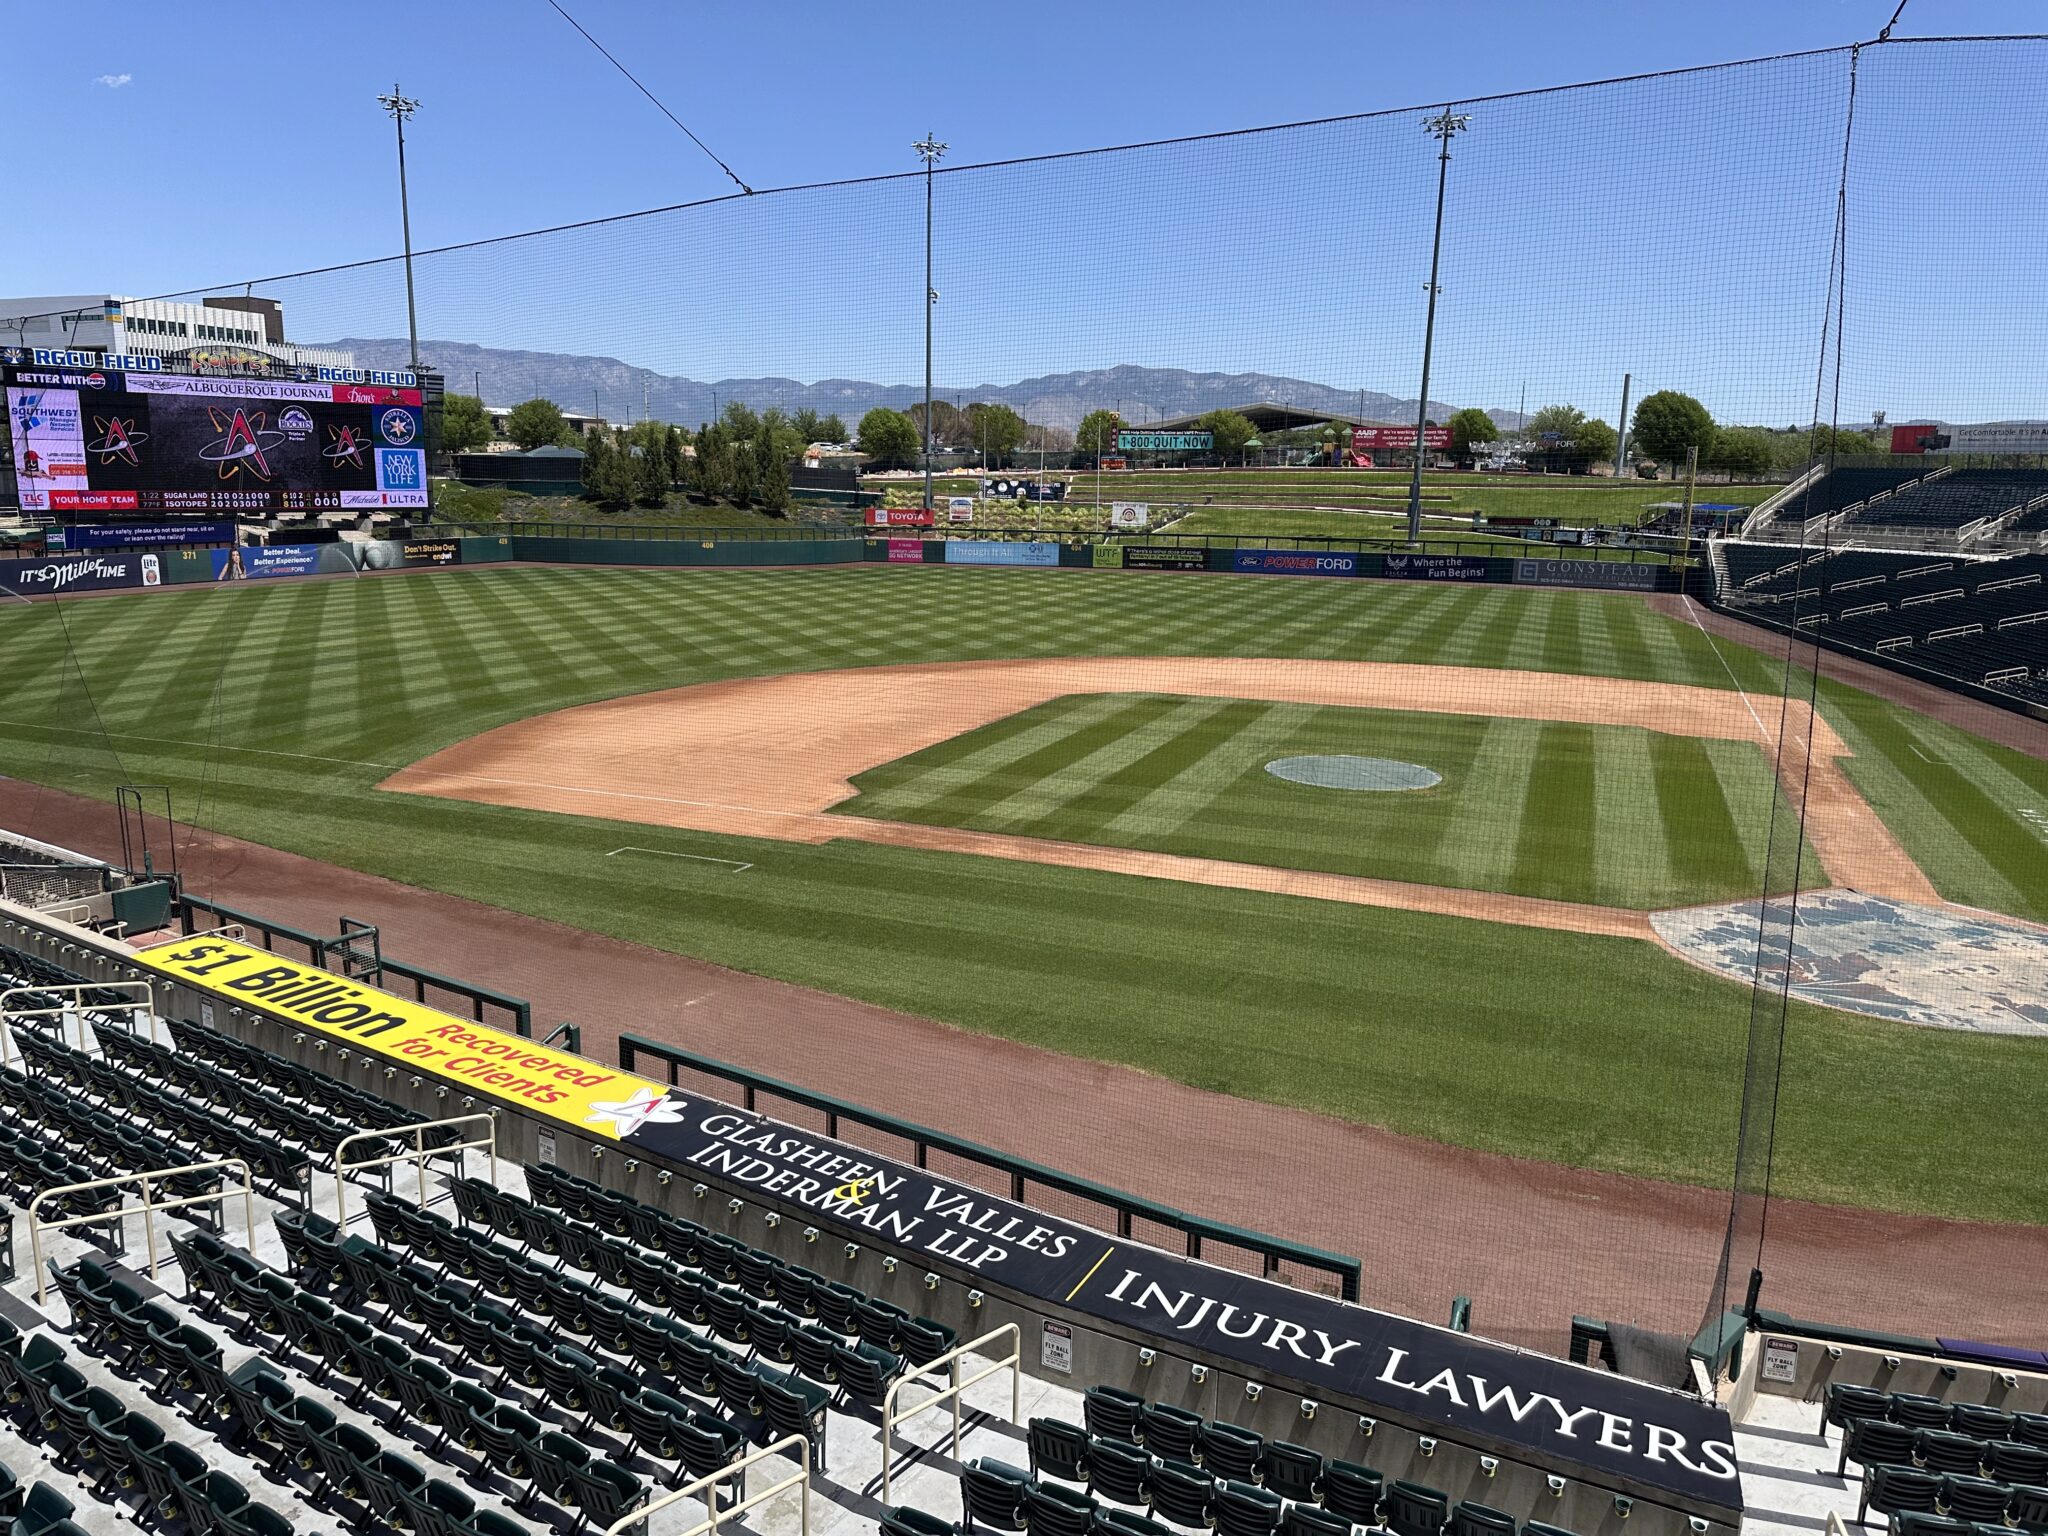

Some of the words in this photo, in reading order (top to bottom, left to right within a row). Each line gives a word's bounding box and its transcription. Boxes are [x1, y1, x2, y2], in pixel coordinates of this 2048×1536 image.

[31, 348, 96, 368] RGCU
[101, 352, 162, 371] FIELD
[16, 373, 60, 384] BETTER
[62, 375, 90, 386] WITH
[317, 366, 365, 383] RGCU
[370, 369, 417, 387] FIELD
[185, 382, 278, 396] ALBUQUERQUE
[280, 386, 332, 399] JOURNAL
[347, 387, 375, 403] Dion's
[11, 407, 78, 417] SOUTHWEST
[388, 454, 412, 465] NEW
[384, 464, 416, 475] YORK
[389, 474, 414, 485] LIFE
[23, 494, 43, 502] TLC
[389, 495, 425, 504] ULTRA
[889, 512, 925, 521] TOYOTA
[182, 551, 197, 559] 371
[404, 545, 422, 553] Don't
[953, 547, 990, 557] Through
[143, 559, 157, 569] Lite
[1264, 556, 1353, 570] POWERFORD
[1413, 558, 1444, 567] Where
[1446, 558, 1462, 566] the
[1546, 561, 1649, 577] GONSTEAD
[20, 569, 47, 583] IT'S
[45, 558, 104, 589] Miller
[95, 565, 126, 578] TIME
[1428, 568, 1446, 577] Fun
[1448, 568, 1485, 579] Begins!
[161, 944, 255, 977] $1
[223, 966, 407, 1038] Billion
[425, 1024, 616, 1088] Recovered
[389, 1038, 451, 1059] for
[444, 1056, 570, 1104] Clients
[700, 1114, 907, 1200] GLASHEEN,
[924, 1185, 1078, 1258] VALLES
[834, 1178, 876, 1206] &
[686, 1141, 922, 1243] INDERMAN,
[924, 1228, 1008, 1269] LLP
[1045, 1341, 1055, 1350] FLY
[1055, 1345, 1069, 1355] BALL
[1050, 1350, 1064, 1358] ZONE
[1105, 1269, 1361, 1367] INJURY
[1375, 1347, 1737, 1479] LAWYERS
